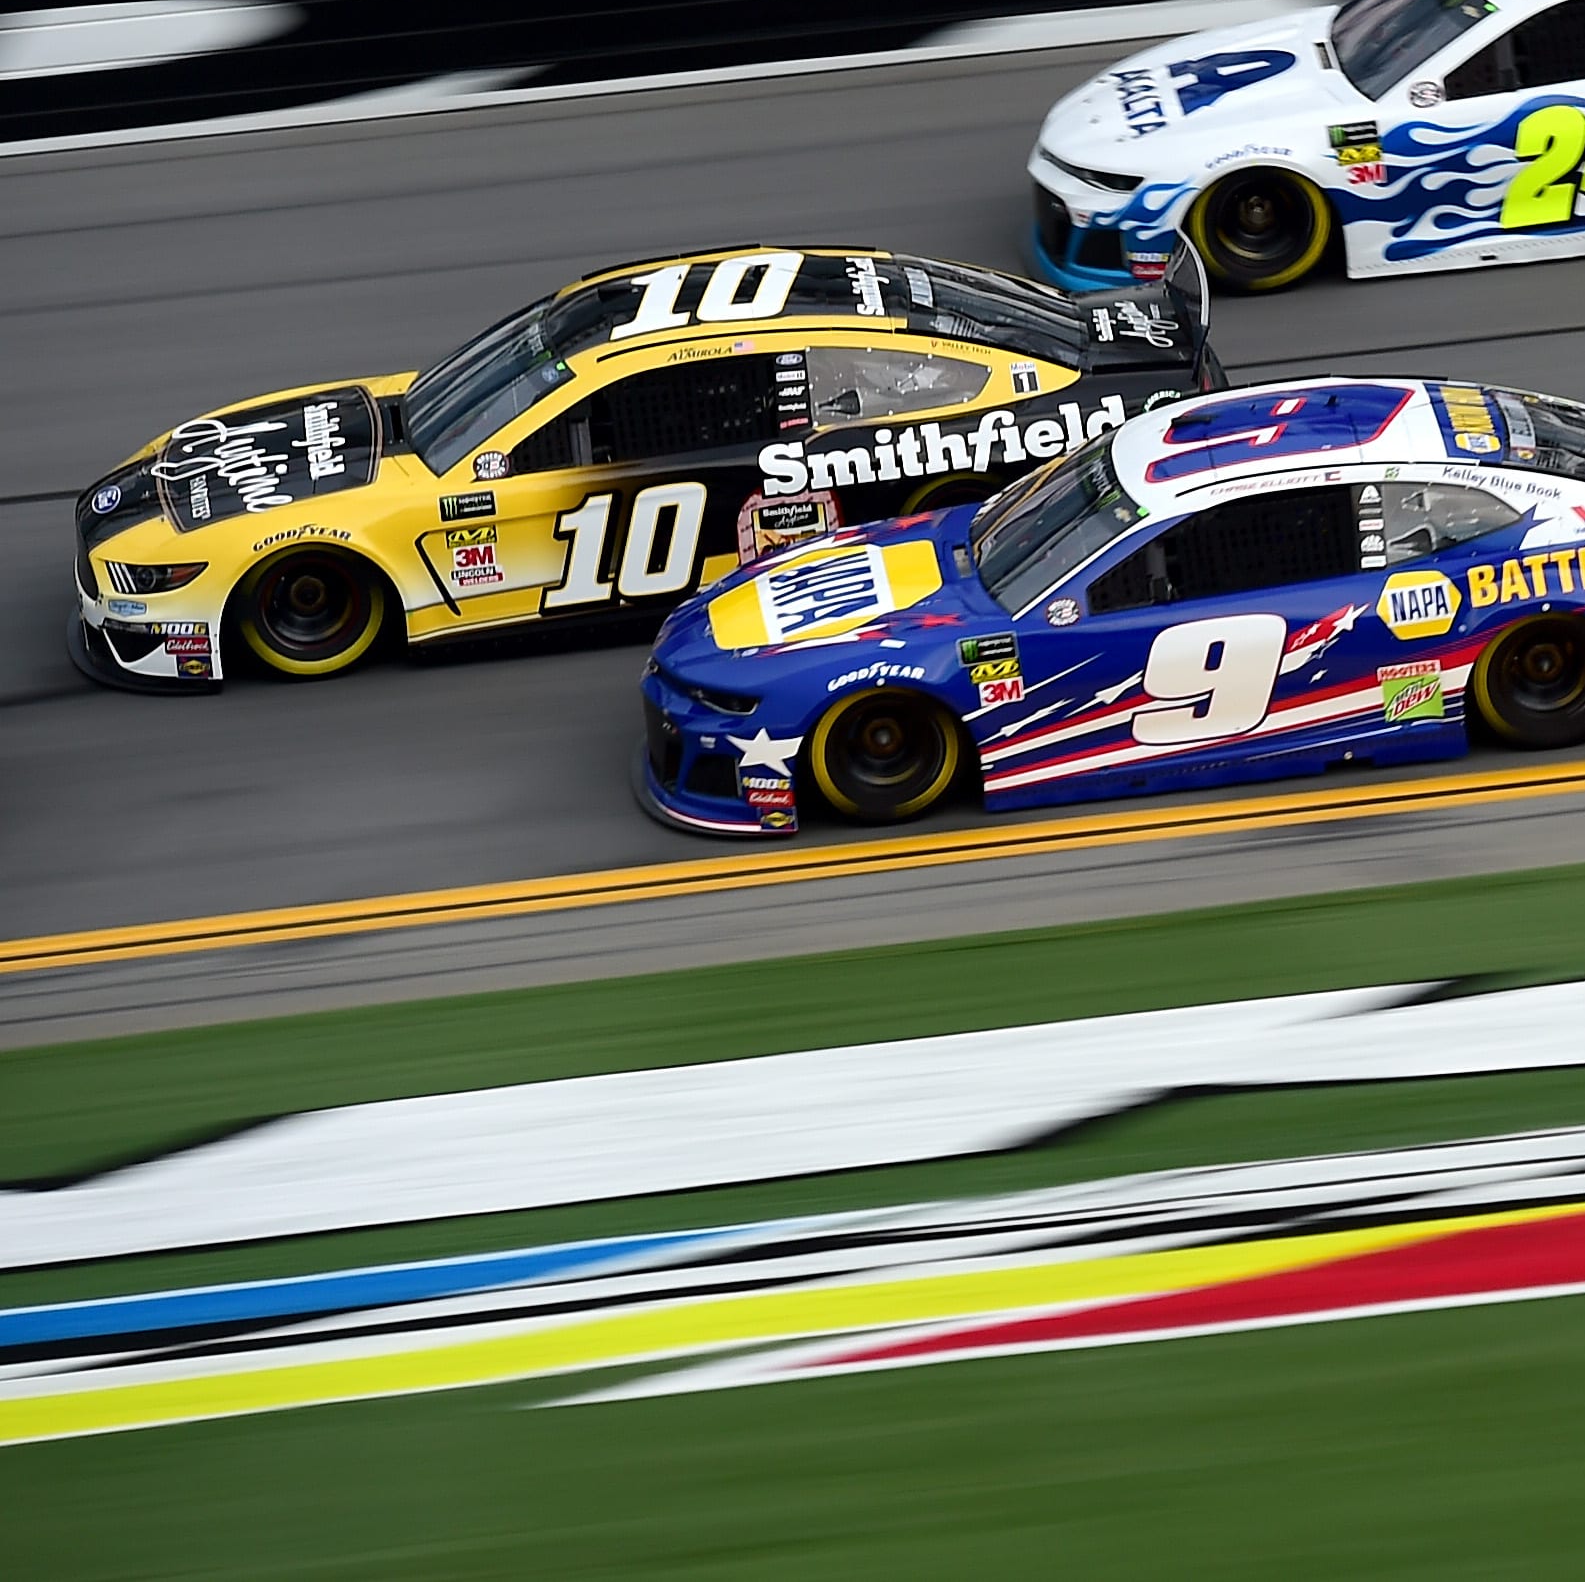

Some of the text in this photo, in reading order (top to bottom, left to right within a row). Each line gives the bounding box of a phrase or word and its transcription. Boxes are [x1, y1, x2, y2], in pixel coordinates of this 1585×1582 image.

[609, 251, 805, 341] 10
[758, 395, 1126, 497] Smithfield
[1442, 466, 1562, 498] Kelley Blue Book
[763, 504, 812, 517] Smithfield
[252, 523, 351, 553] GOODYEAR
[543, 480, 707, 610] 10
[456, 546, 493, 568] 3M
[453, 567, 494, 579] LINCOLN
[769, 551, 879, 634] NAPA
[1391, 585, 1448, 622] NAPA
[151, 623, 206, 635] MOOG
[167, 639, 209, 651] Edelbrock
[828, 662, 925, 691] GOODYEAR
[1133, 613, 1287, 745] 9
[1380, 663, 1437, 679] HOOTERS
[983, 681, 1021, 702] 3M
